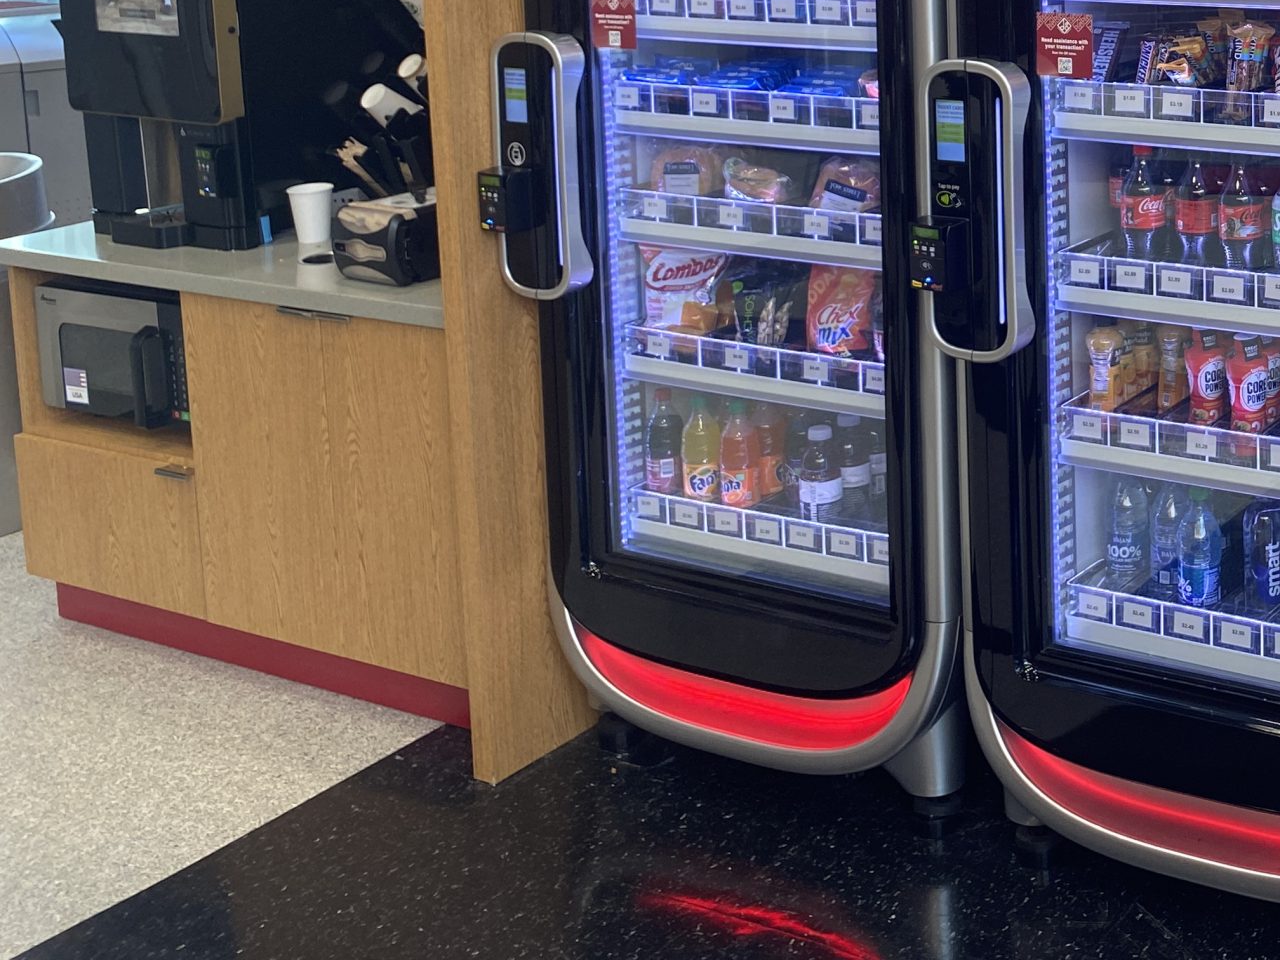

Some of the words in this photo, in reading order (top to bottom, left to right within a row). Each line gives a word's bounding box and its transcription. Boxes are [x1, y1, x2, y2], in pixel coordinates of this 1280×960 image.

[1234, 37, 1243, 60] KIND
[1136, 40, 1152, 85] SNICKER
[1138, 197, 1165, 213] Coca
[653, 254, 718, 283] Combos
[817, 299, 864, 326] Chex
[1205, 381, 1226, 393] POWE
[1246, 379, 1267, 394] CORE
[1247, 391, 1266, 404] POWE
[690, 471, 719, 493] Fan
[1107, 544, 1142, 557] 100%
[1265, 541, 1280, 597] smart
